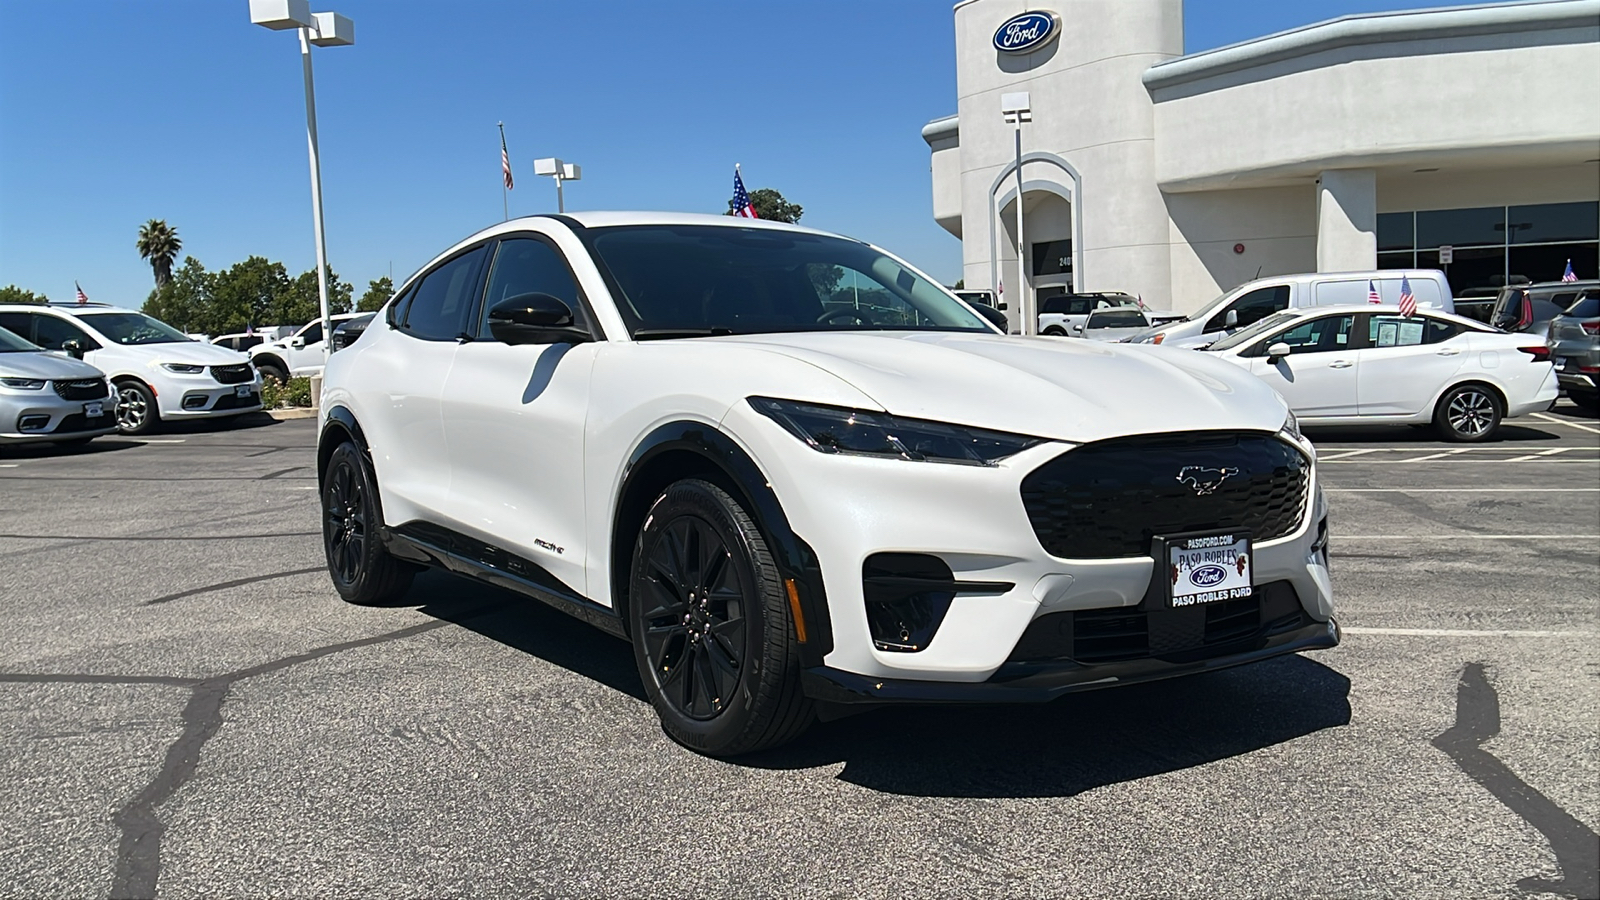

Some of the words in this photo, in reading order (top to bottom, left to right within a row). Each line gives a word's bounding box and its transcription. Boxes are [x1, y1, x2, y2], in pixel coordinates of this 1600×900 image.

[1003, 18, 1040, 46] Ford
[1059, 256, 1073, 267] 240
[1188, 535, 1233, 548] PASOFORD.COM
[1179, 552, 1201, 573] PASO
[1204, 549, 1237, 566] ROBLES
[1197, 568, 1220, 584] Ford
[1172, 596, 1195, 607] PASO
[1196, 590, 1229, 604] ROBLES
[1230, 587, 1252, 598] FORD
